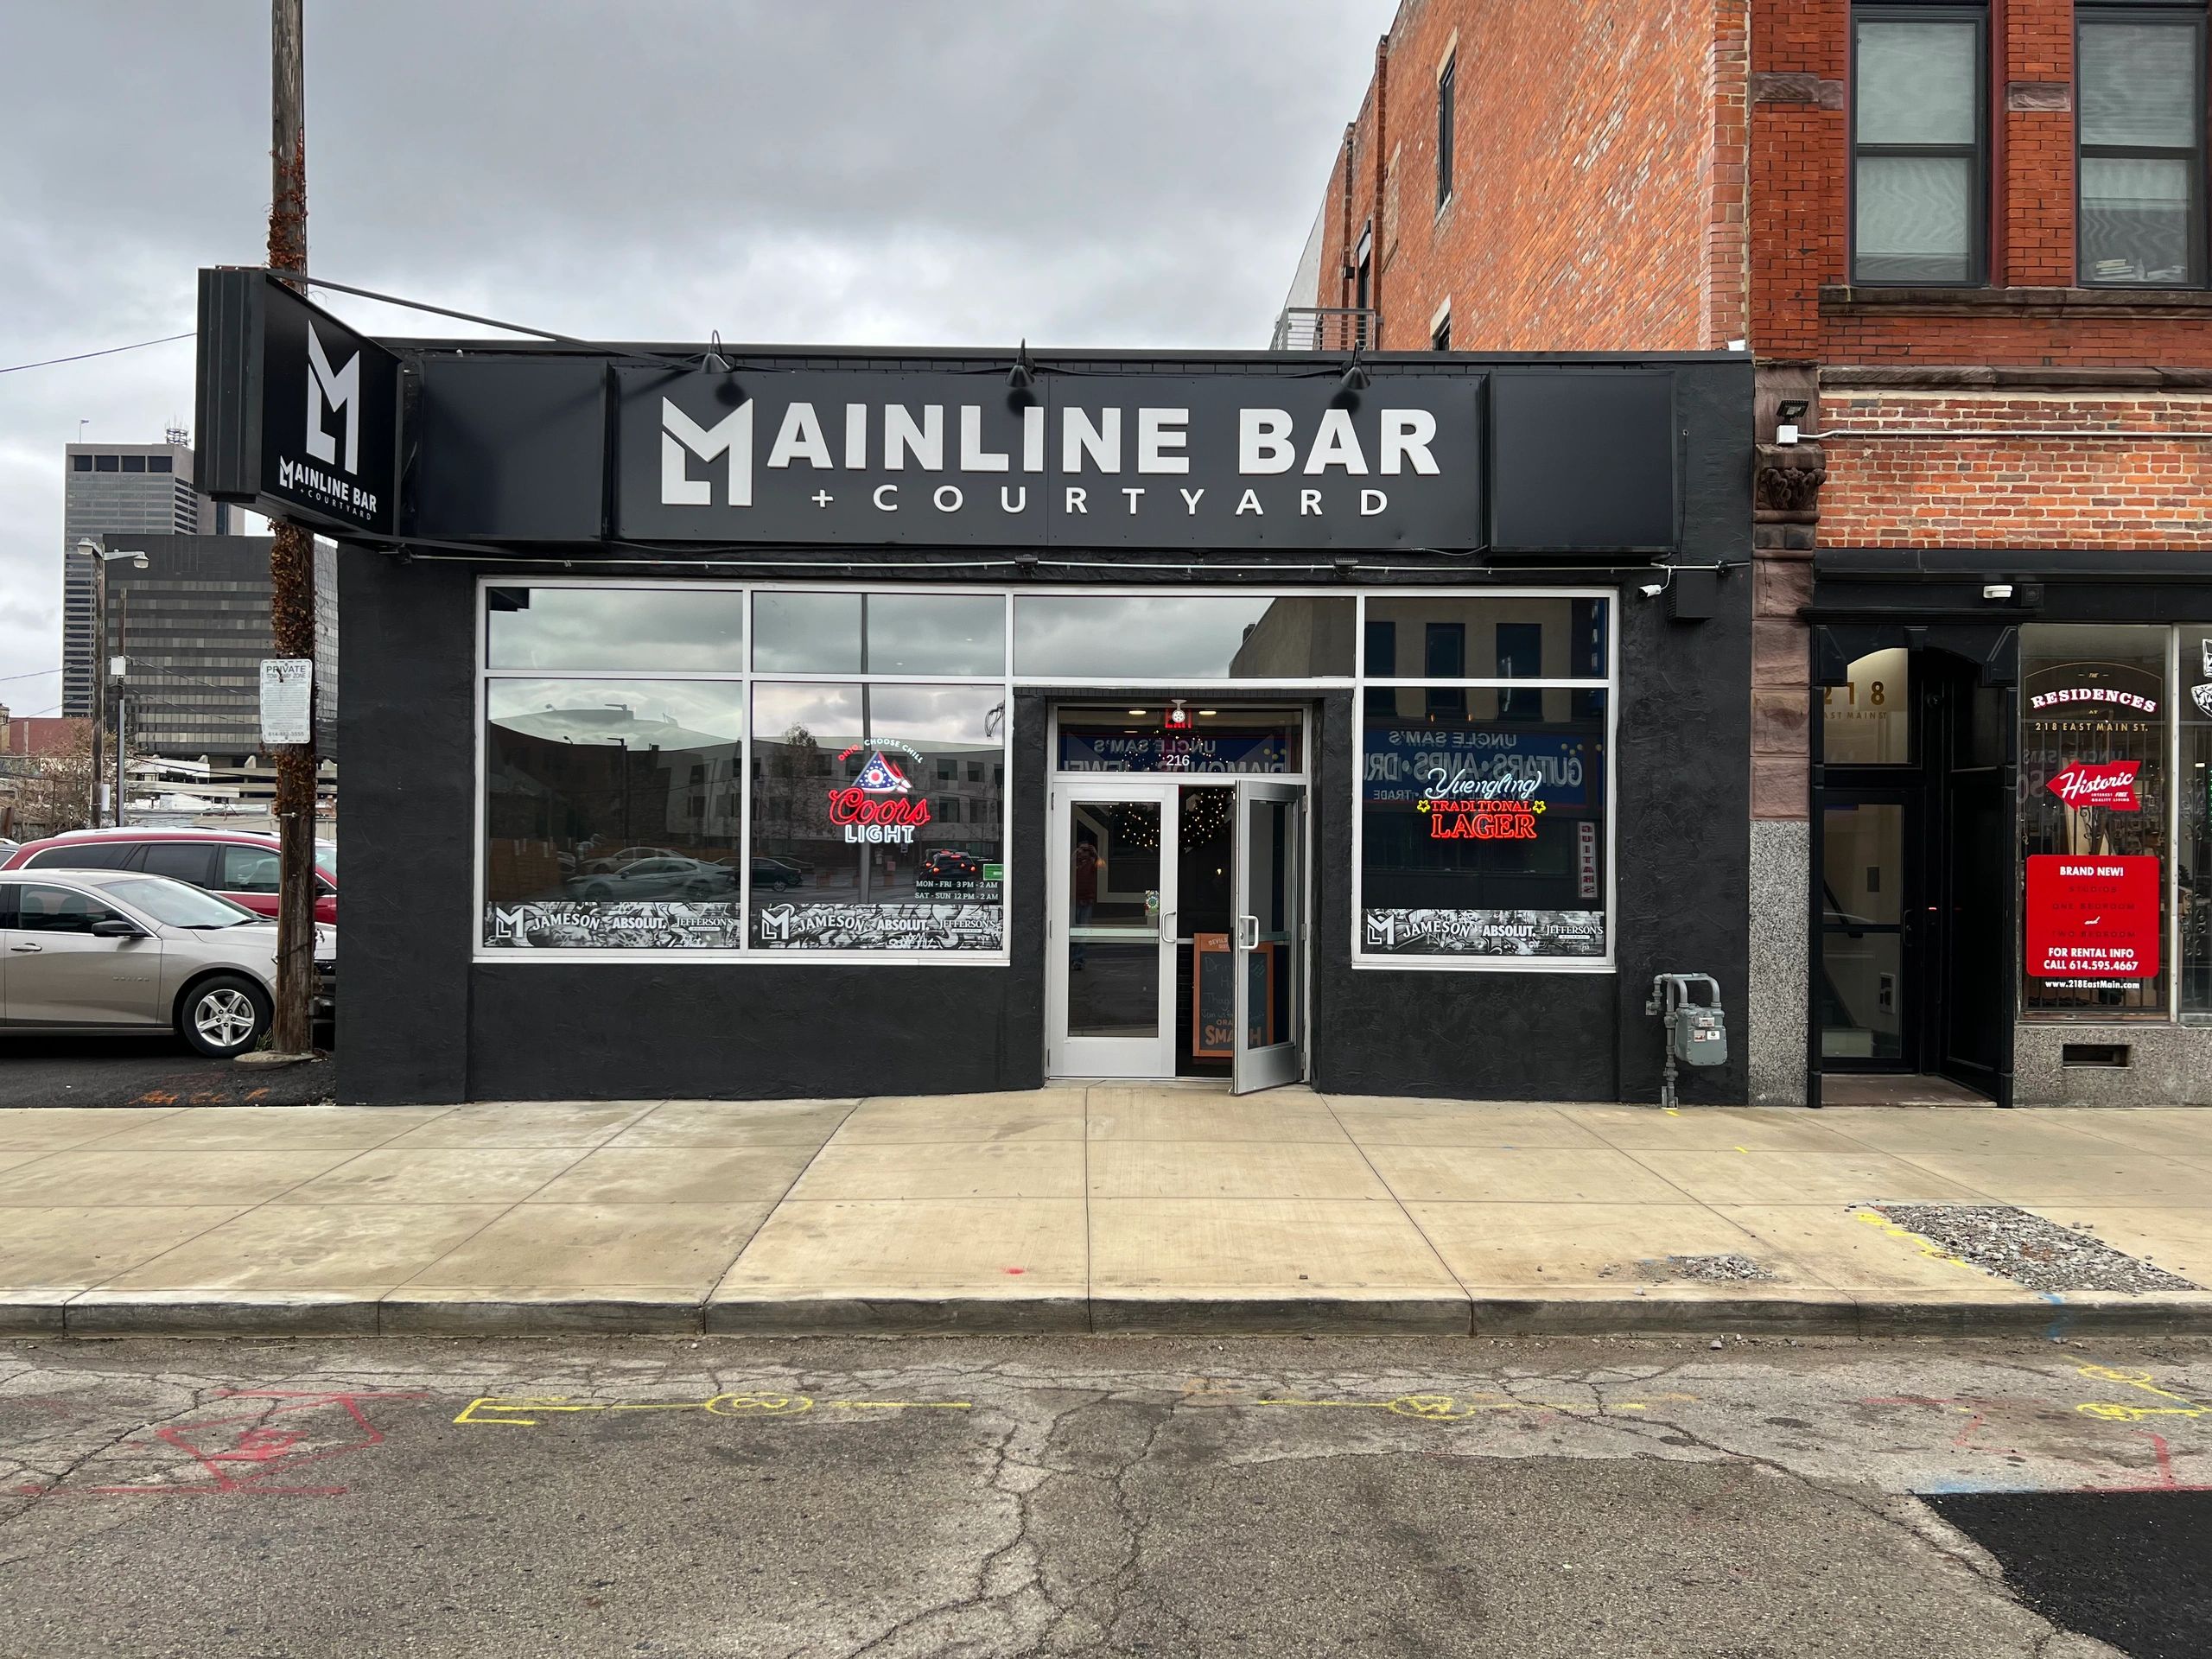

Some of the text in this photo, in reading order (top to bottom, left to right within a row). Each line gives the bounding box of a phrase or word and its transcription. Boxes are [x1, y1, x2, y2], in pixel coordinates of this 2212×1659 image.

[662, 396, 1441, 507] MAINLINE BAR
[279, 454, 377, 513] MAINLINE BAR
[308, 490, 372, 521] COURTYARD
[873, 483, 1389, 517] COURTYARD
[2031, 688, 2158, 714] RESIDENCES
[2036, 722, 2149, 732] 218 EAST MAIN ST.
[864, 739, 900, 747] CHOOSE
[901, 744, 924, 764] CHILL
[1166, 754, 1191, 766] 216
[1425, 767, 1542, 799] Yuengling
[2059, 769, 2134, 800] Historic
[829, 787, 931, 826] Coors
[1431, 800, 1532, 812] TRADITIONAL
[844, 824, 916, 843] LIGHT
[1431, 814, 1537, 839] LAGER
[2059, 866, 2124, 877] BRAND NEW!
[532, 913, 601, 931] JAMESON
[677, 917, 734, 928] JEFFERSON'S
[798, 915, 866, 932] JAMESON
[938, 918, 996, 930] JEFFERSON'S
[1402, 920, 1471, 938] JAMESON
[1545, 925, 1605, 936] JEFFERSON'S
[2048, 947, 2134, 958] FOR RENTAL INFO
[2044, 960, 2139, 970] CALL 614.595.4667
[2045, 979, 2140, 989] www.218EastMain.com
[1205, 1025, 1262, 1047] SMAH
